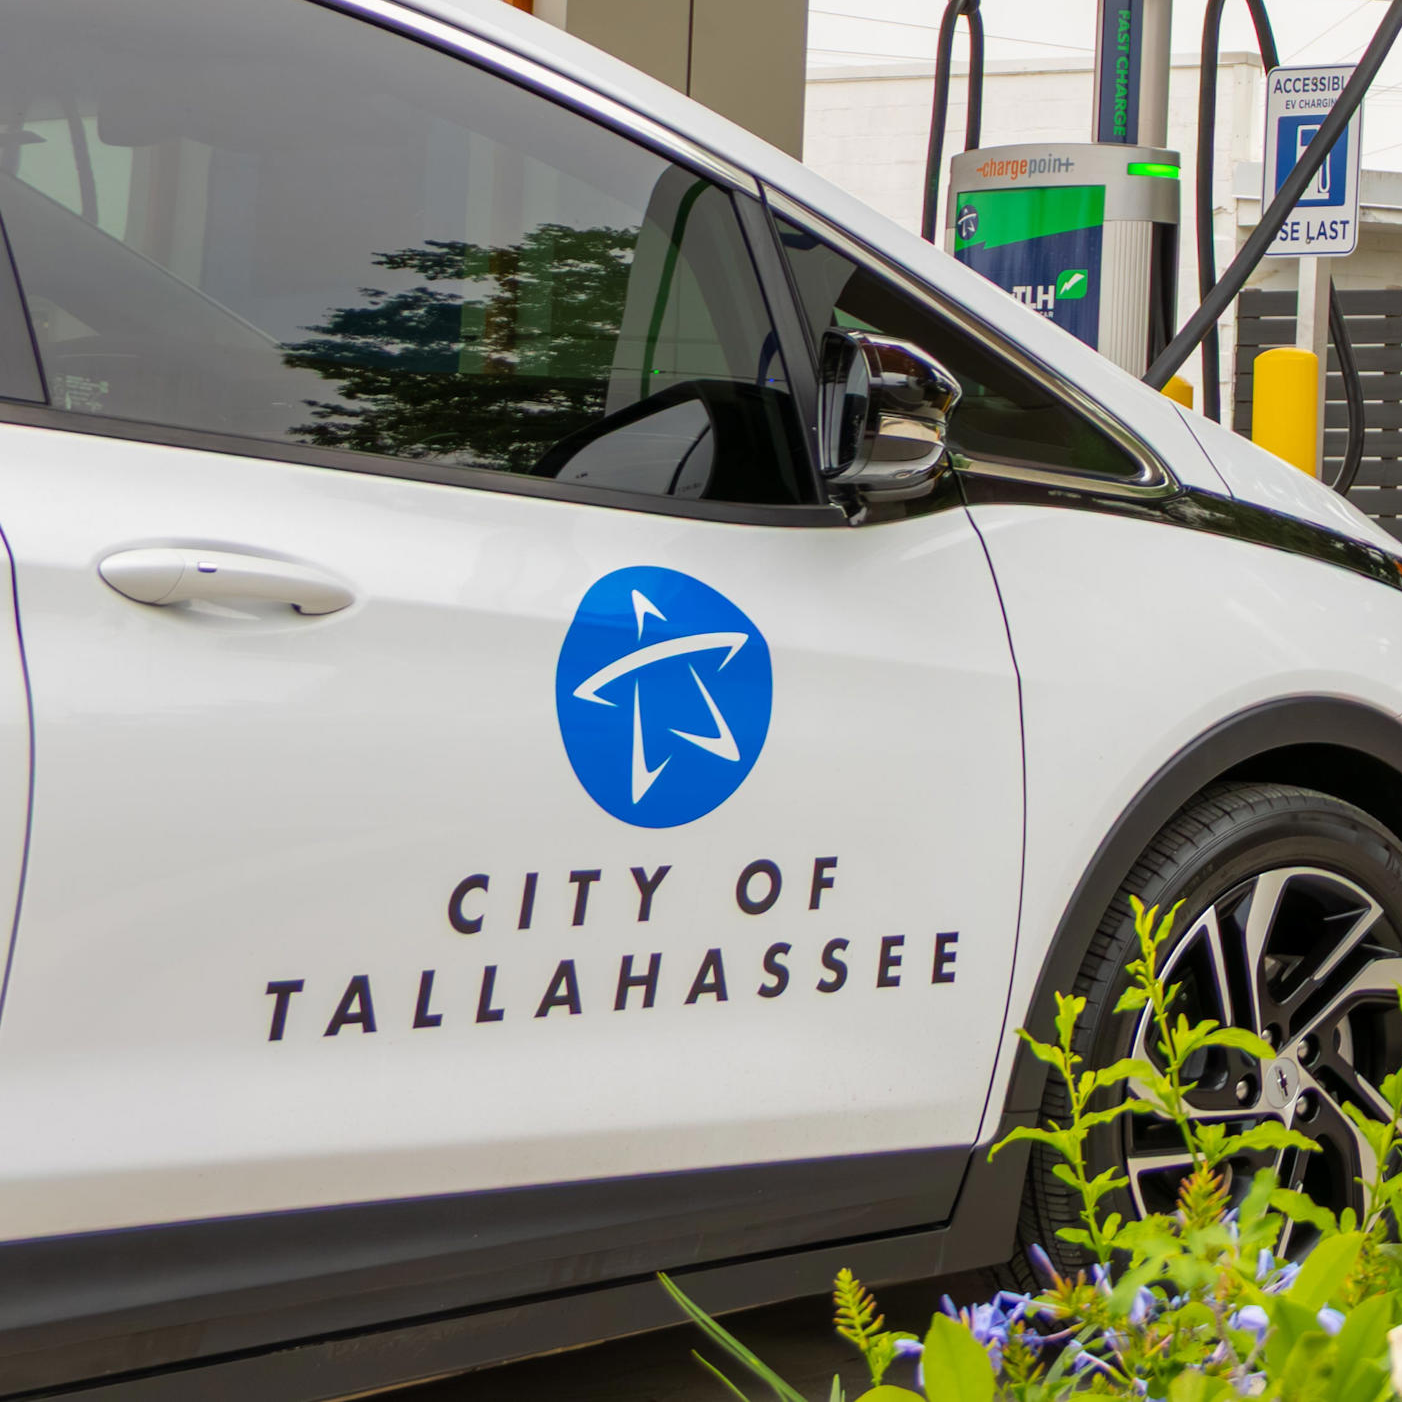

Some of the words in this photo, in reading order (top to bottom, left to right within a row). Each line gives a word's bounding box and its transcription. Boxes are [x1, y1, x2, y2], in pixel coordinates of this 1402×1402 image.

[1116, 9, 1131, 55] FAST
[1113, 56, 1129, 137] CHARGE
[1274, 75, 1350, 94] ACCESSIBL
[1285, 99, 1297, 110] EV
[1299, 98, 1338, 109] CHARGIN
[1306, 220, 1350, 242] LAST
[448, 865, 672, 935] CITY
[735, 856, 839, 916] OF
[265, 931, 959, 1042] TALLAHASSEE
